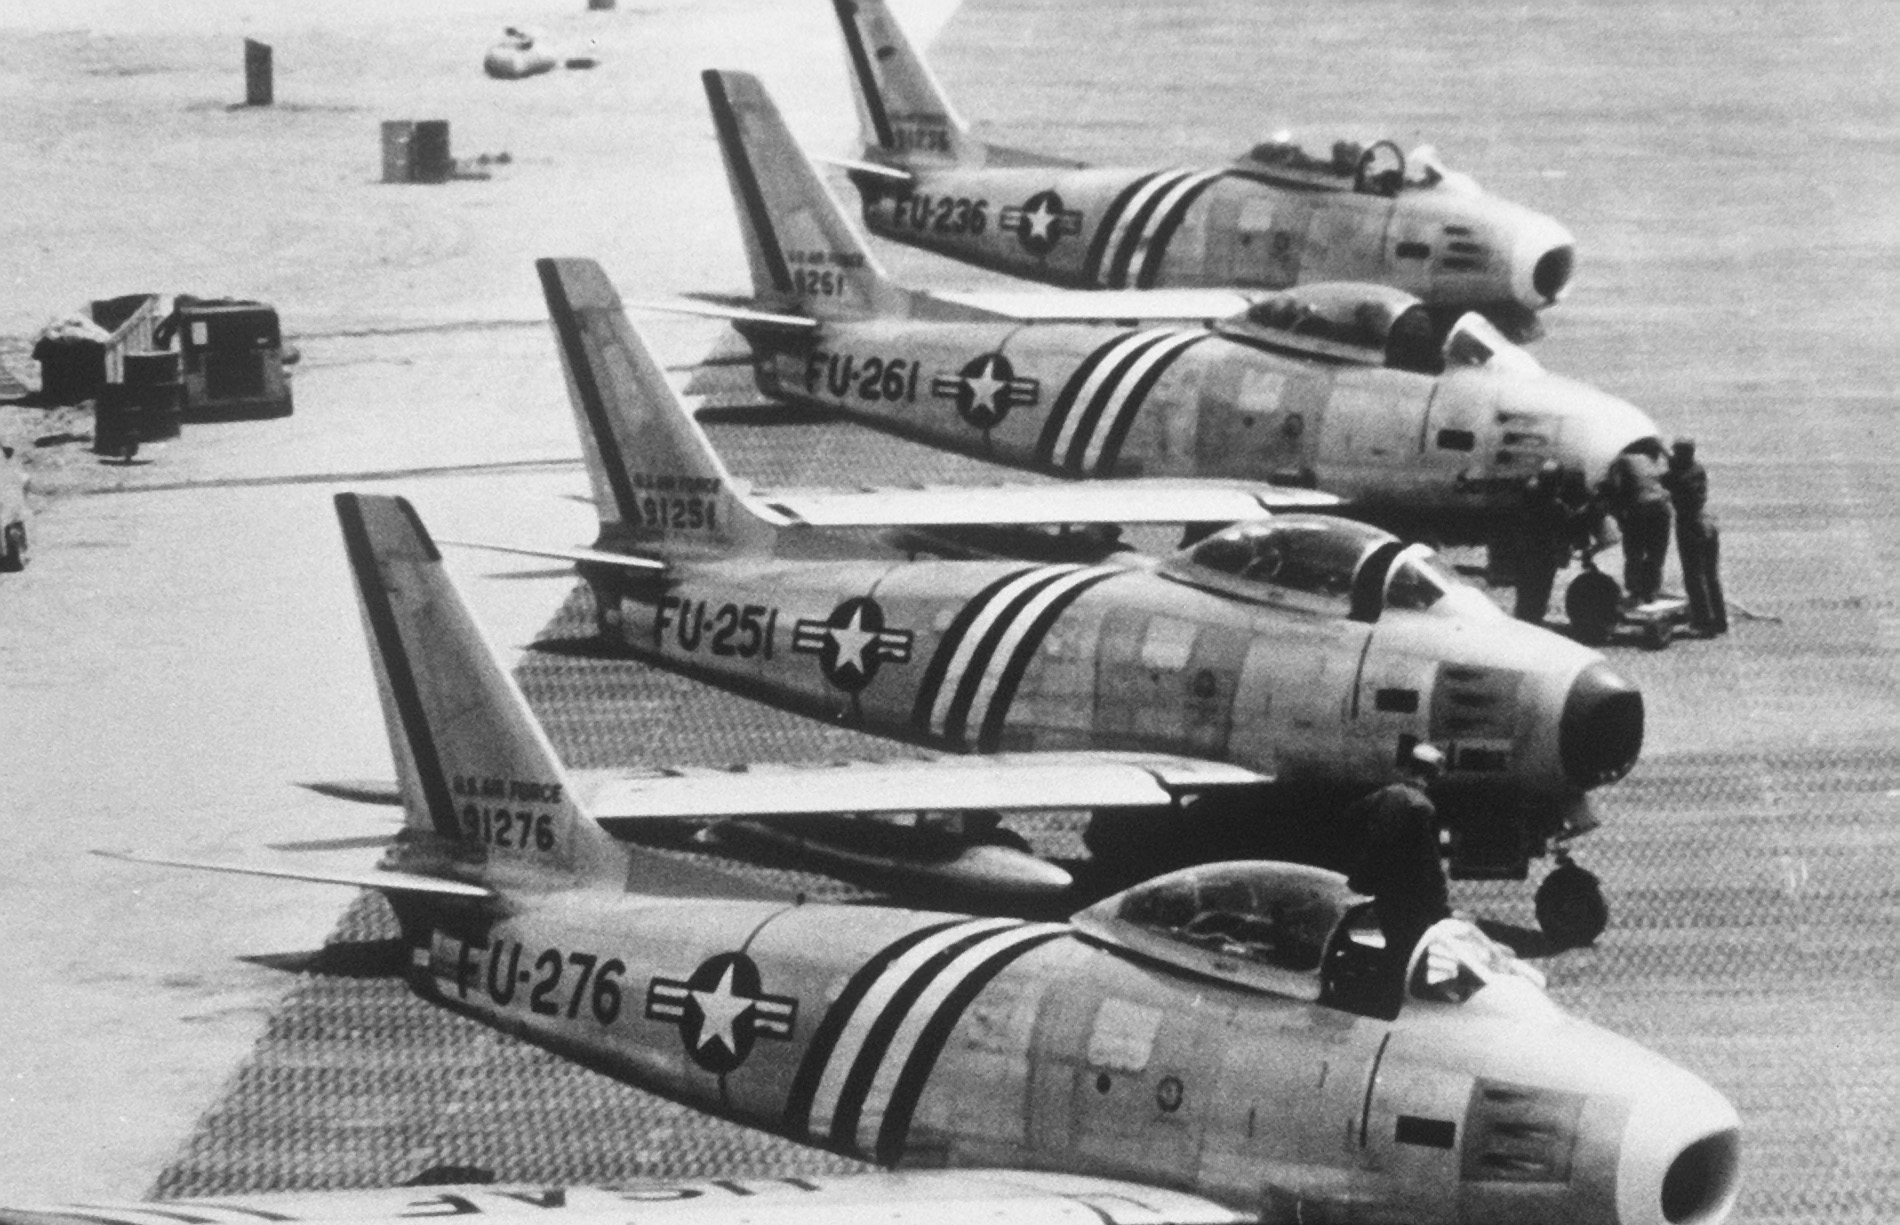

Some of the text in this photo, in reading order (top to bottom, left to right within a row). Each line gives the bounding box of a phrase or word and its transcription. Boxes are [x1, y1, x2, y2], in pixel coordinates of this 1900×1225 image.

[893, 192, 989, 237] FU-236
[805, 351, 920, 403] FU-261
[643, 497, 716, 532] 91251
[655, 595, 779, 660] FU-251
[508, 778, 563, 804] FORCE
[462, 804, 556, 853] 91276
[457, 938, 627, 1026] FU-276
